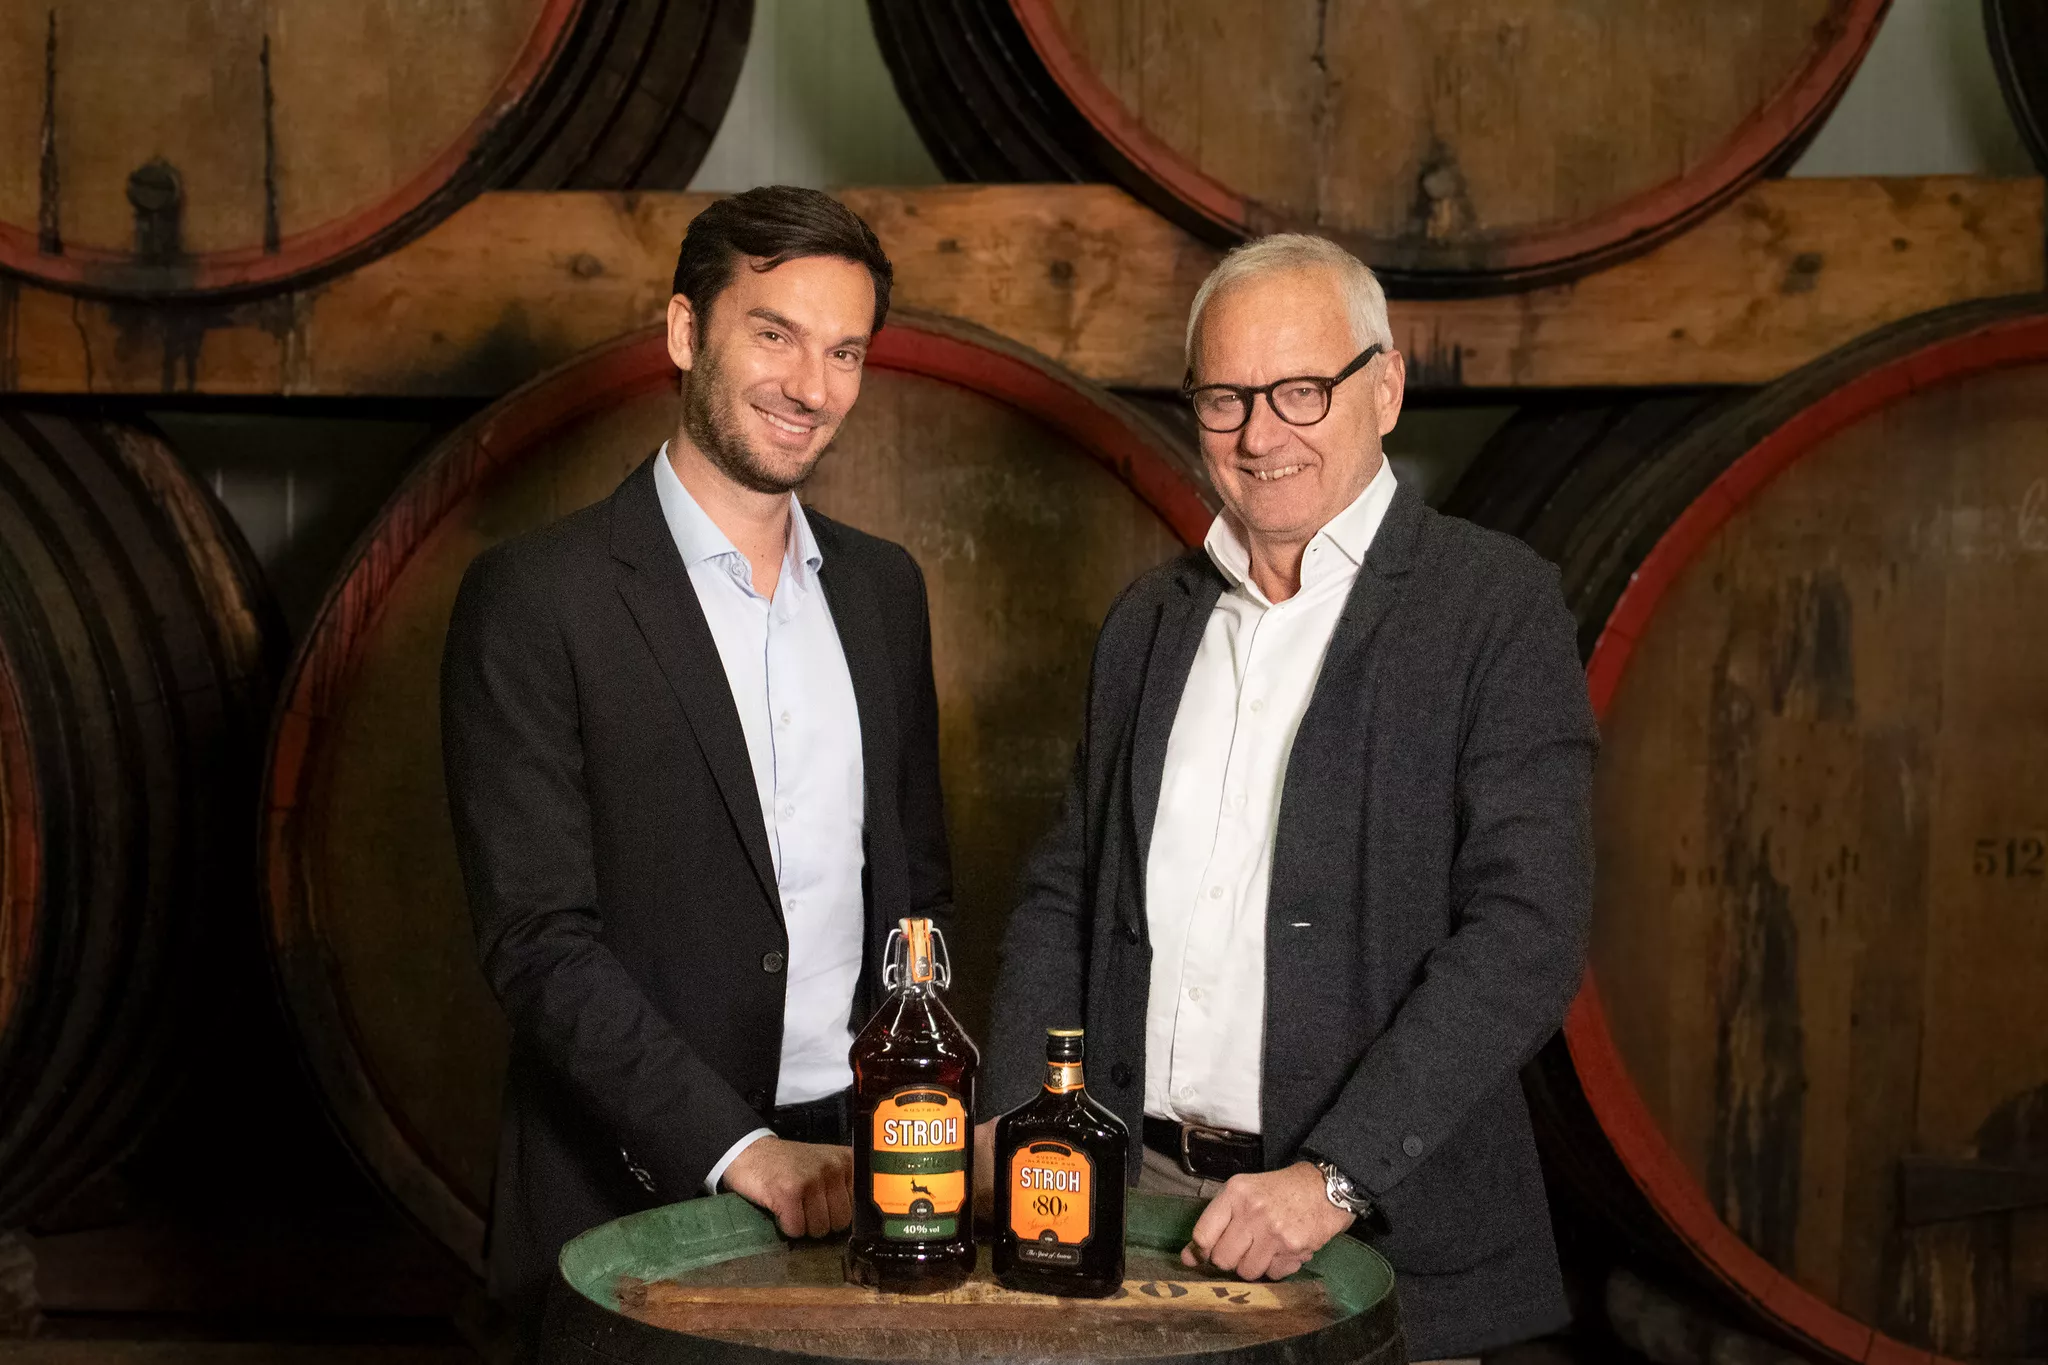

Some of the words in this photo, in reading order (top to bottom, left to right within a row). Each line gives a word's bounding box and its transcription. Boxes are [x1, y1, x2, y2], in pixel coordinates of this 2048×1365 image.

[1973, 838, 2045, 878] 512
[884, 1117, 957, 1146] STROH
[1020, 1166, 1081, 1193] STROH
[903, 1224, 928, 1234] 40%
